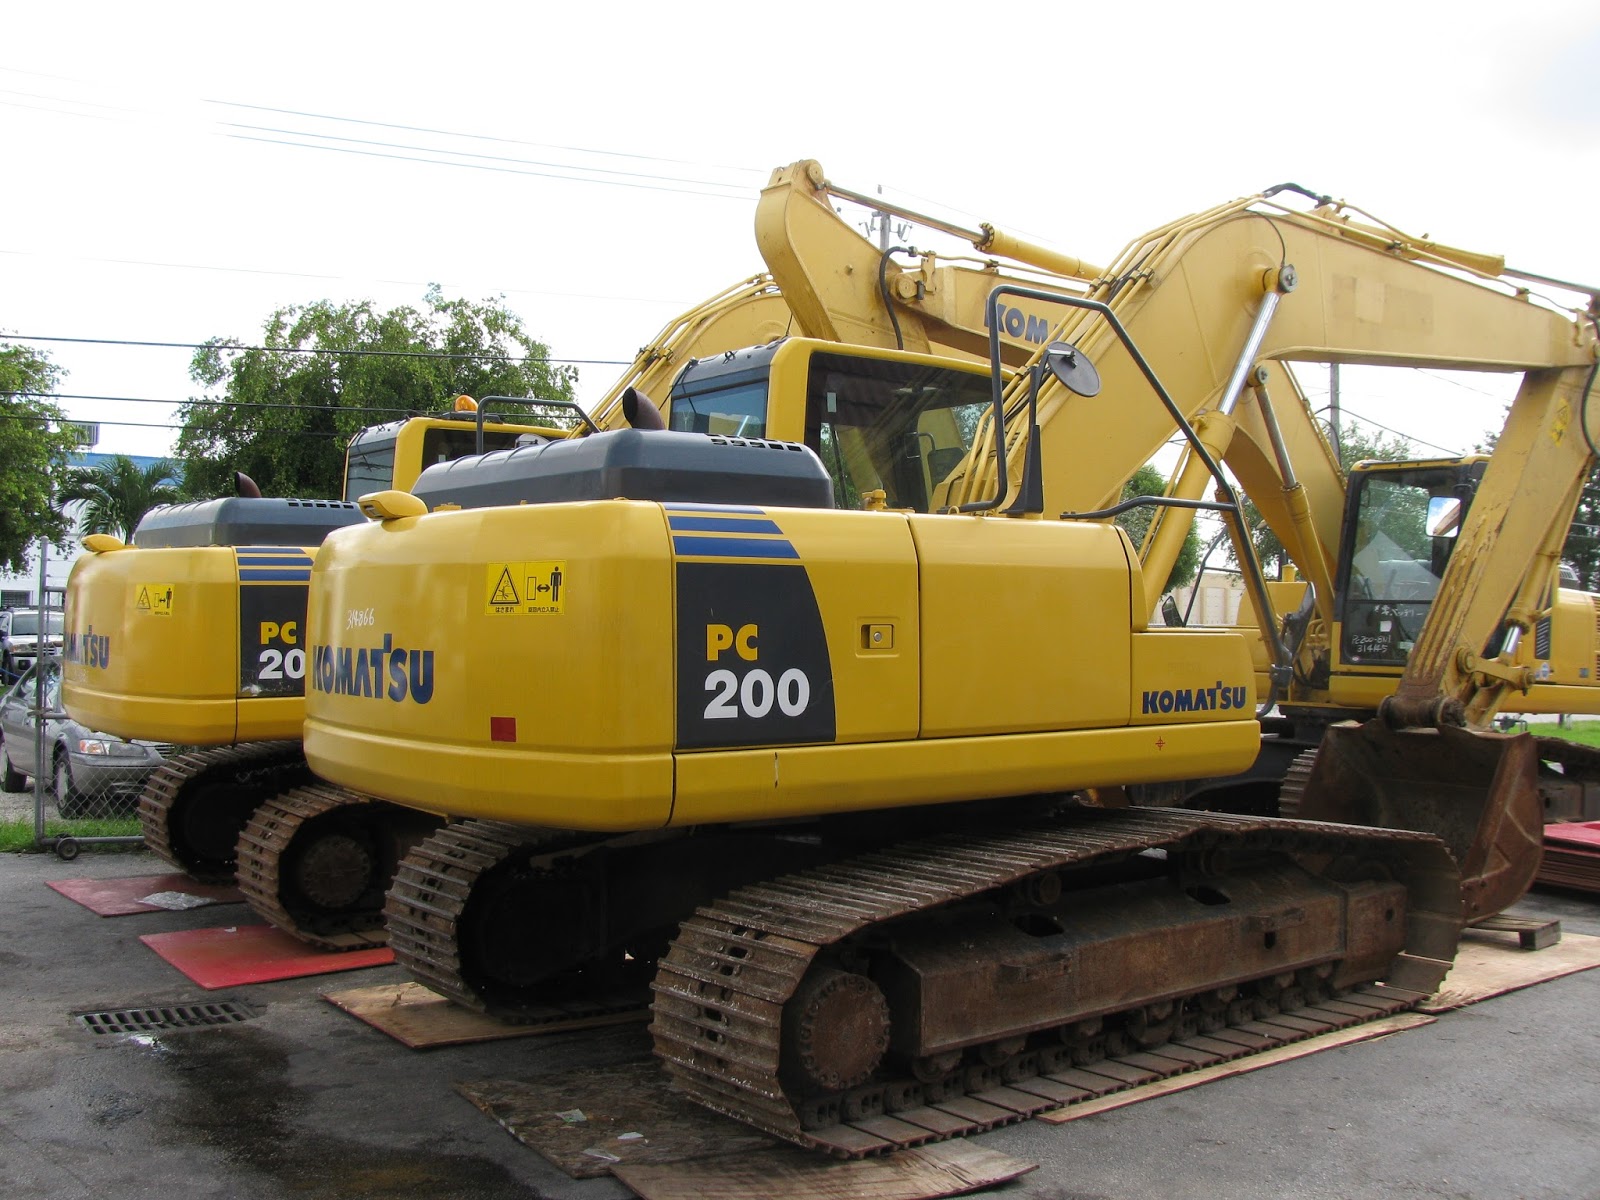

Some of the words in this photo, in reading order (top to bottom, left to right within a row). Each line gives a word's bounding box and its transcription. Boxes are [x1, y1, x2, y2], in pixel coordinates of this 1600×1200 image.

[260, 621, 297, 645] PC
[706, 623, 758, 661] PC
[312, 633, 434, 704] KOMATSU
[703, 668, 810, 719] 200
[1142, 681, 1246, 714] KOMATSU
